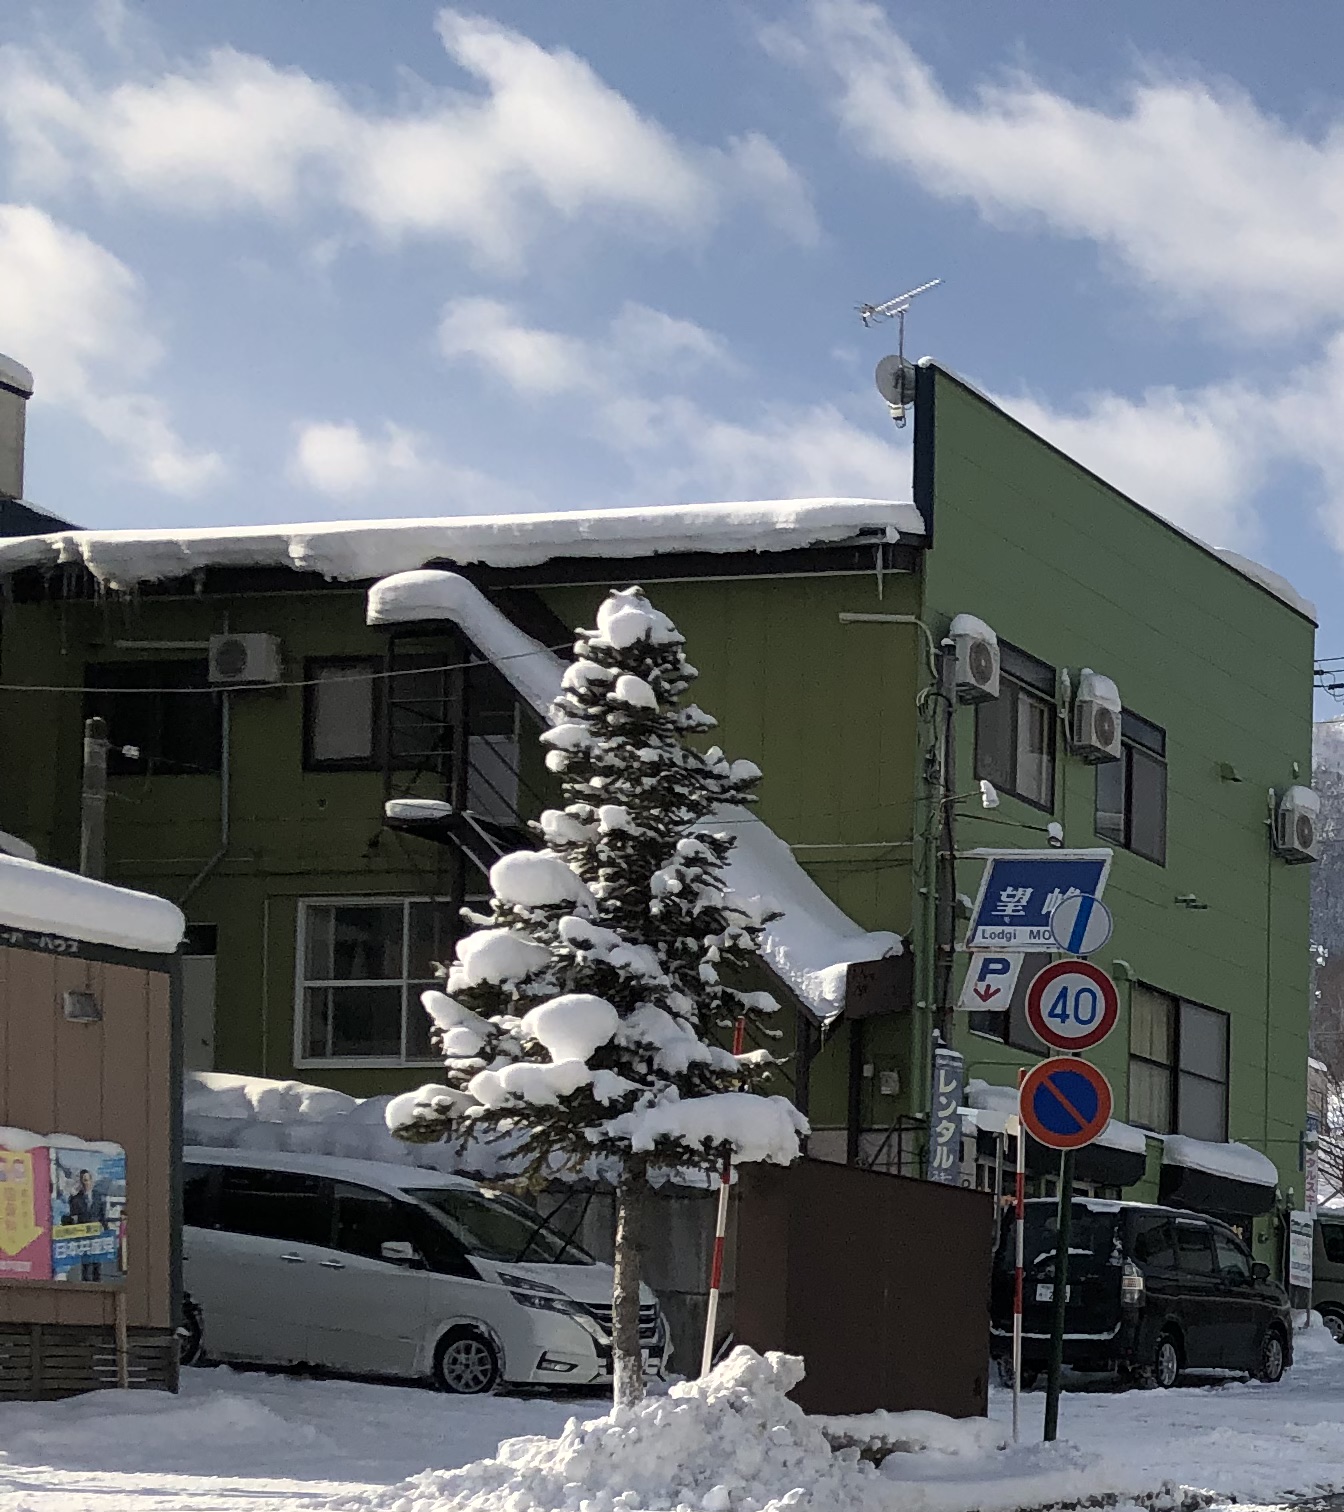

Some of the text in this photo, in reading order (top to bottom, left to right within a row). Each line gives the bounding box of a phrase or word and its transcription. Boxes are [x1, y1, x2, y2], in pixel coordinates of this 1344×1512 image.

[981, 929, 1051, 942] Lodgi MO
[976, 957, 1011, 982] P
[1047, 985, 1097, 1025] 40
[932, 1069, 957, 1169] レンタル
